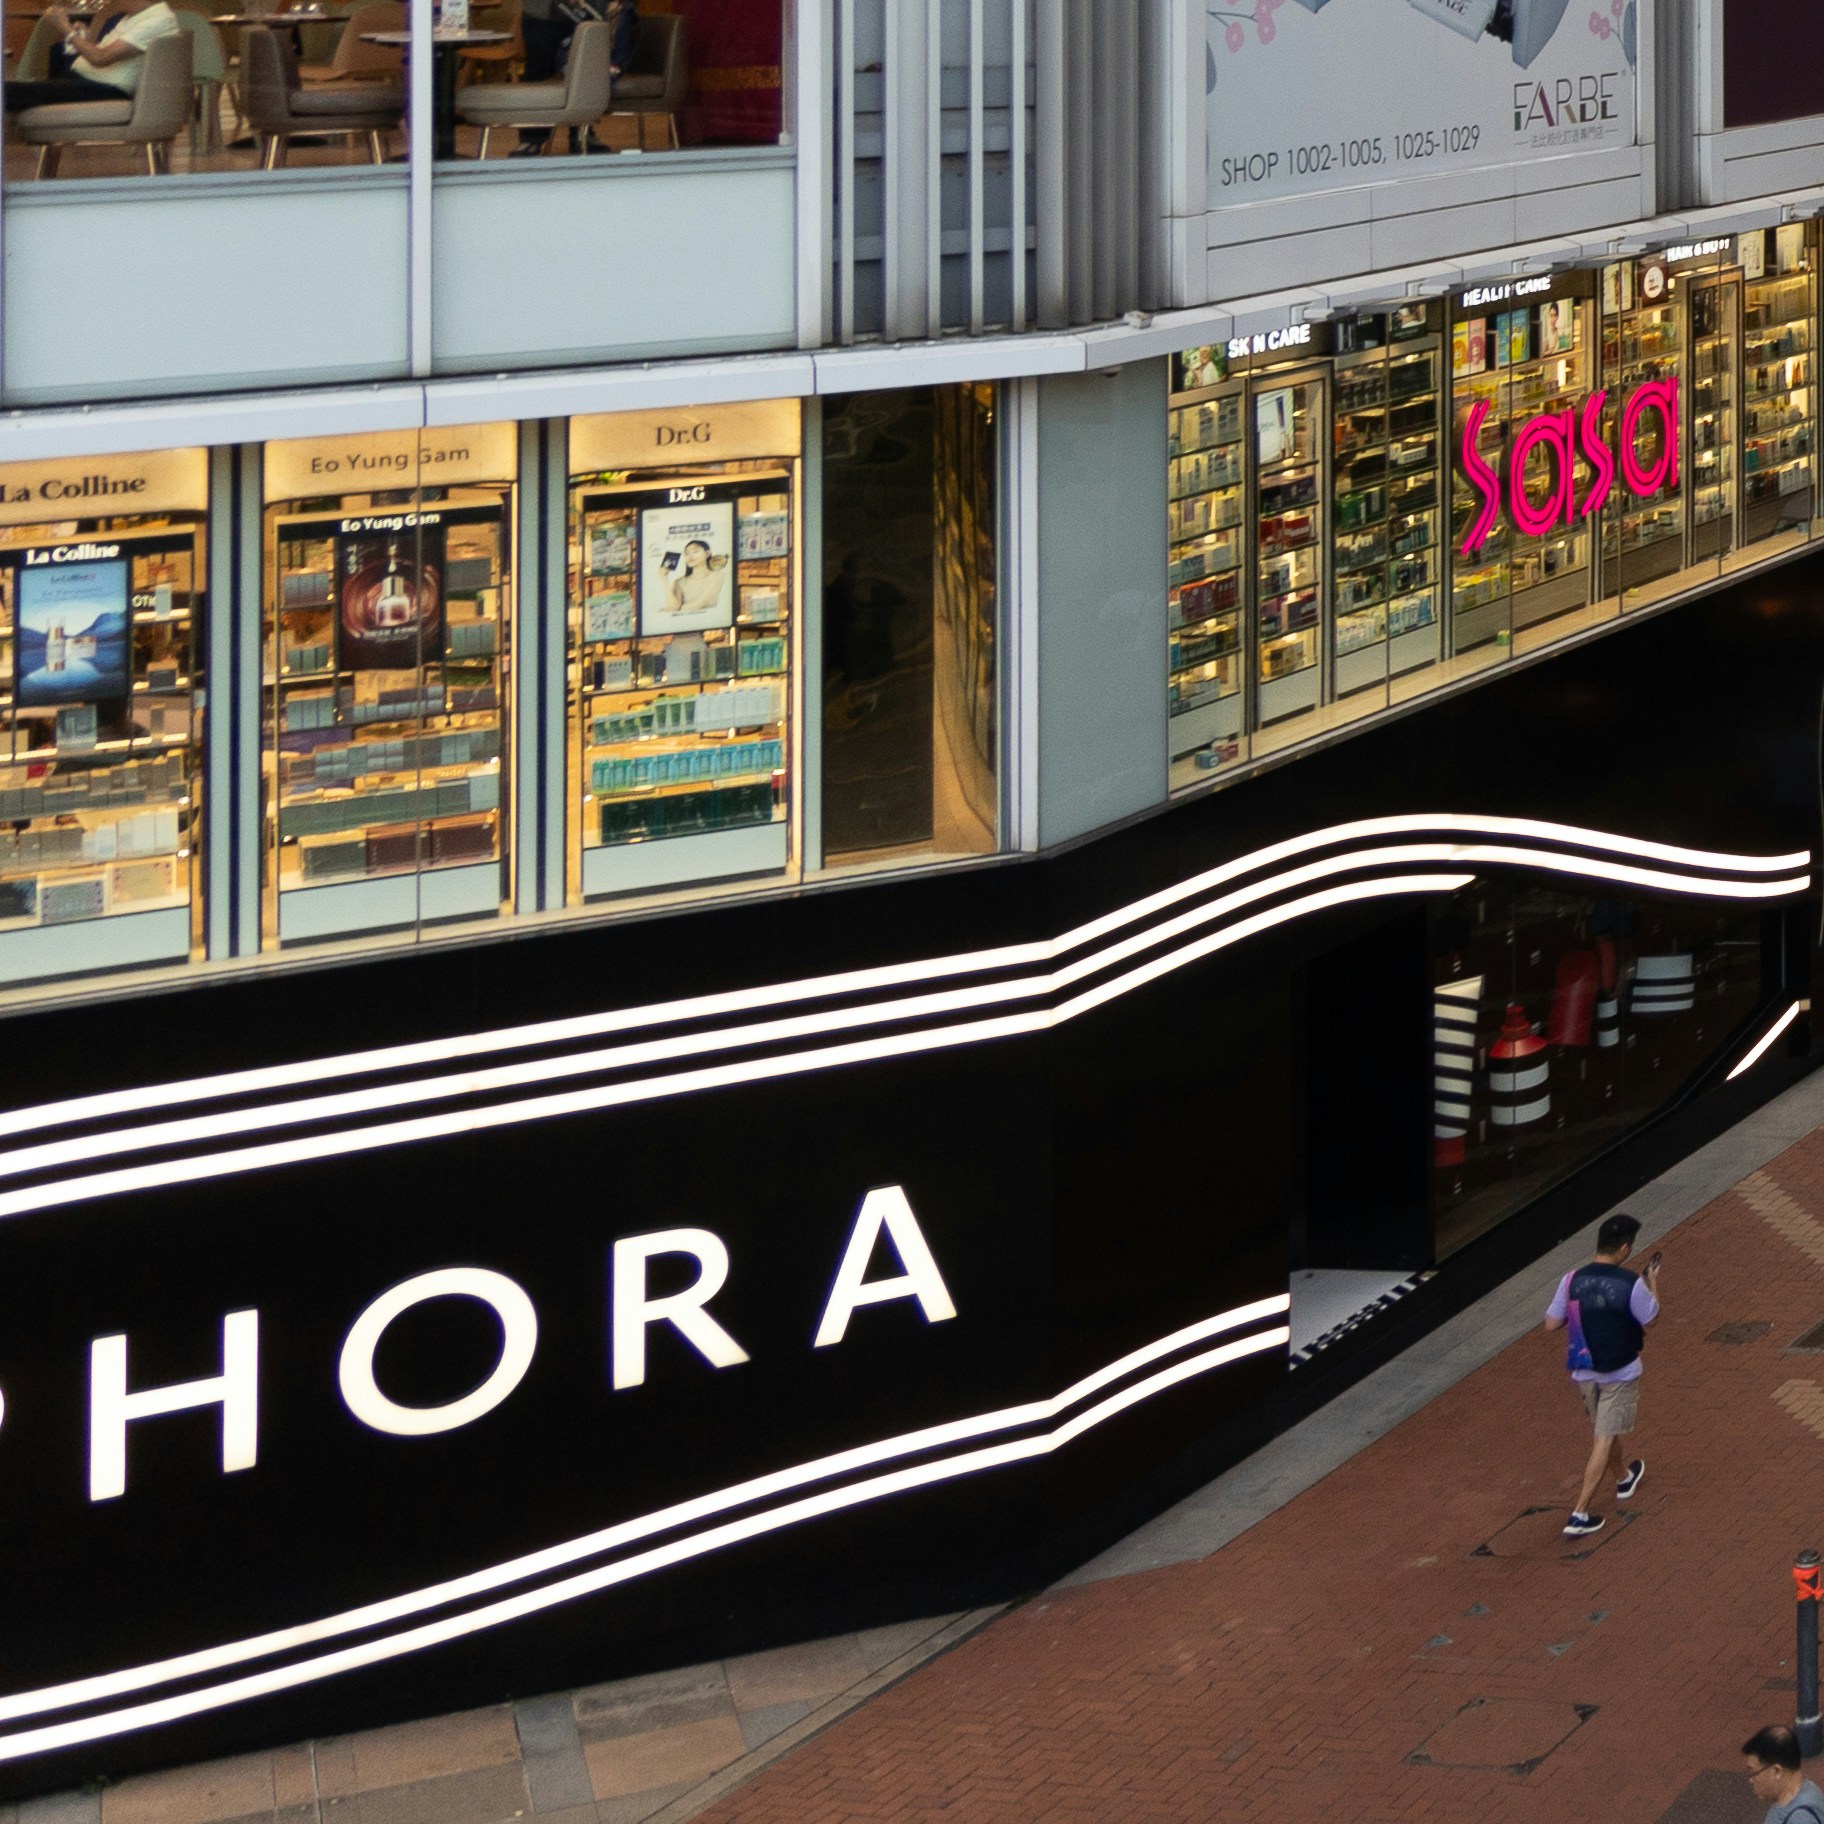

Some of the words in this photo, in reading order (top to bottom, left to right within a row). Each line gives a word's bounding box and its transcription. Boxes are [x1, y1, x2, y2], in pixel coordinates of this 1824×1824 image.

[1513, 72, 1618, 132] FARBE
[1221, 152, 1278, 186] SHOP
[1286, 136, 1387, 174] 1002-1005,
[1393, 124, 1481, 158] 1025-1029
[1268, 323, 1311, 349] CARE
[656, 423, 711, 447] Dr.G
[311, 457, 339, 474] Eo
[347, 452, 408, 472] Yung
[1462, 377, 1678, 556] sasa
[39, 475, 146, 500] Colline
[669, 486, 705, 503] Dr.G
[341, 519, 361, 532] Eo
[363, 516, 402, 530] Yung
[26, 550, 50, 565] La
[51, 543, 120, 562] Colline
[0, 1183, 957, 1502] HORA
